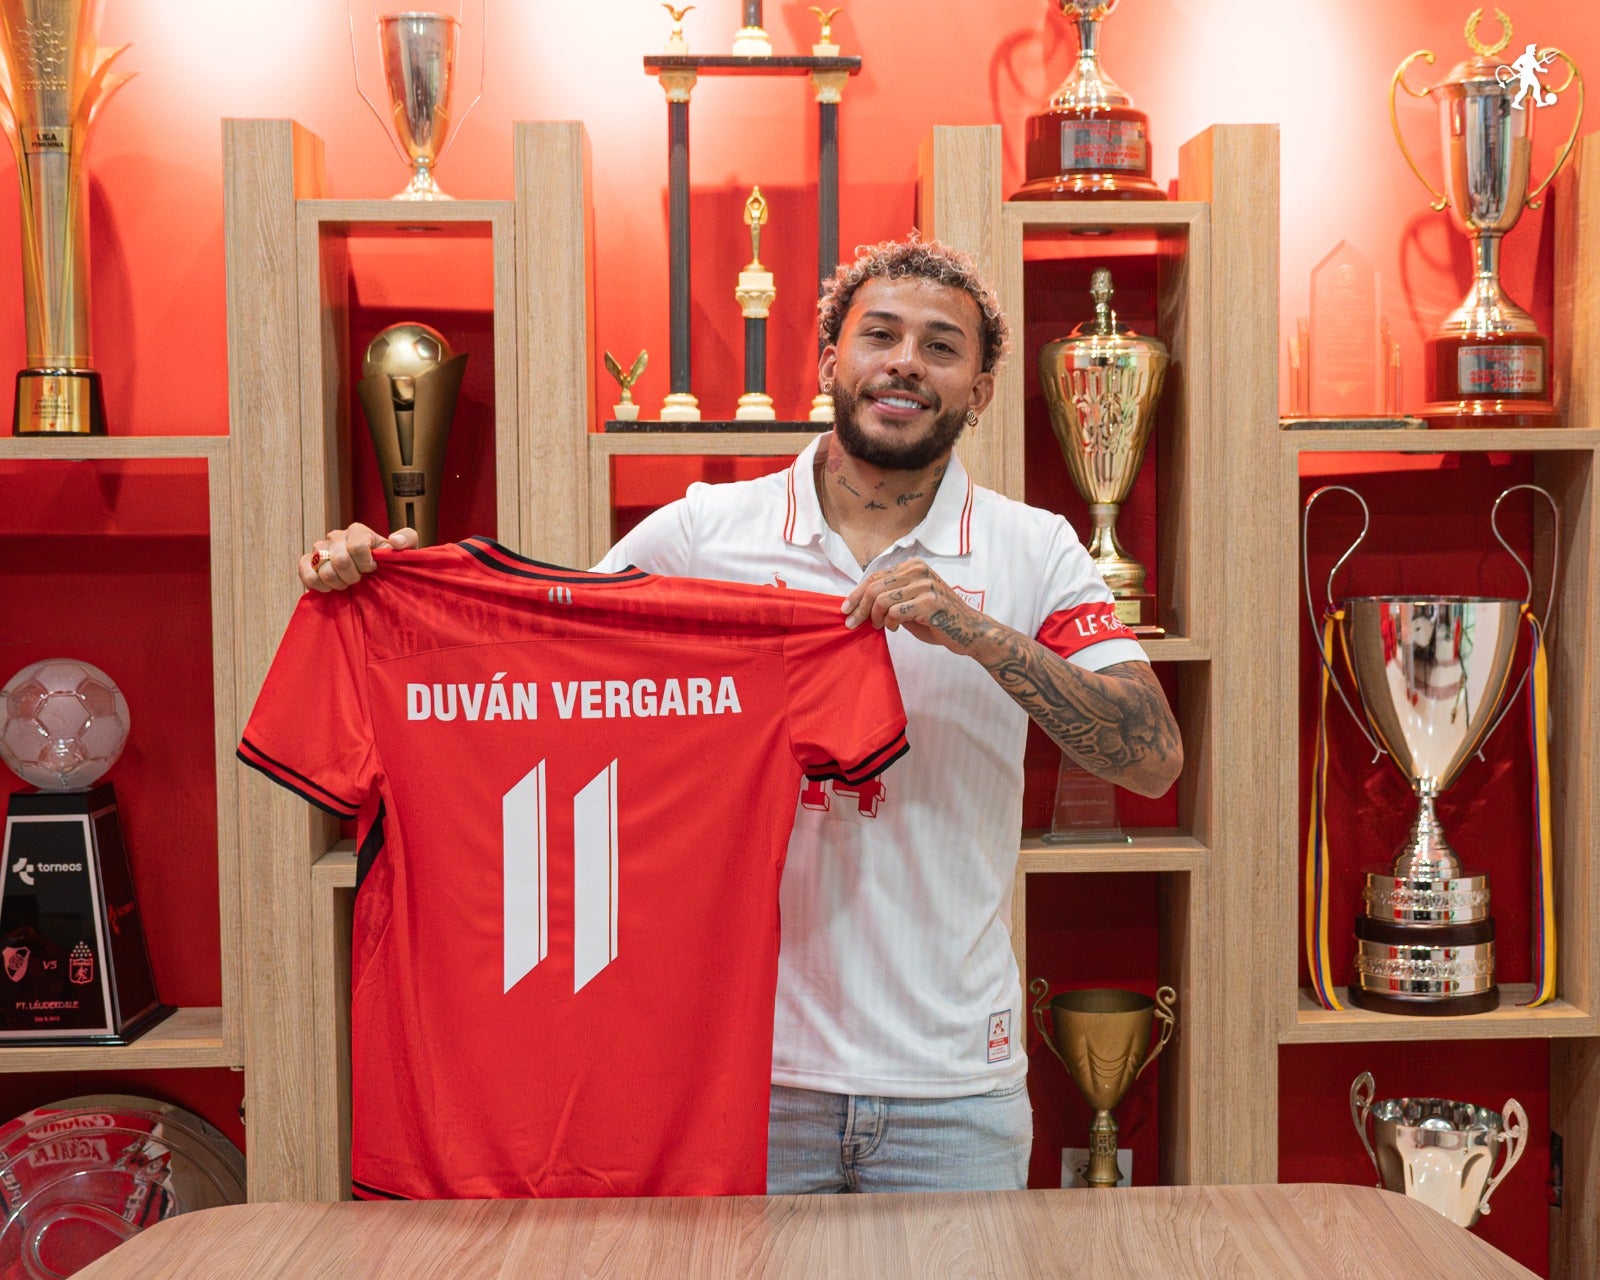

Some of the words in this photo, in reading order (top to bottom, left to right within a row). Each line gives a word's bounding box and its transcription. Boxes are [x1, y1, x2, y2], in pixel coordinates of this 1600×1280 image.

[1074, 613, 1098, 637] LE
[406, 671, 538, 721] DUVÁN
[551, 676, 742, 720] VERGARA
[37, 862, 82, 872] torneos
[502, 757, 619, 995] 11
